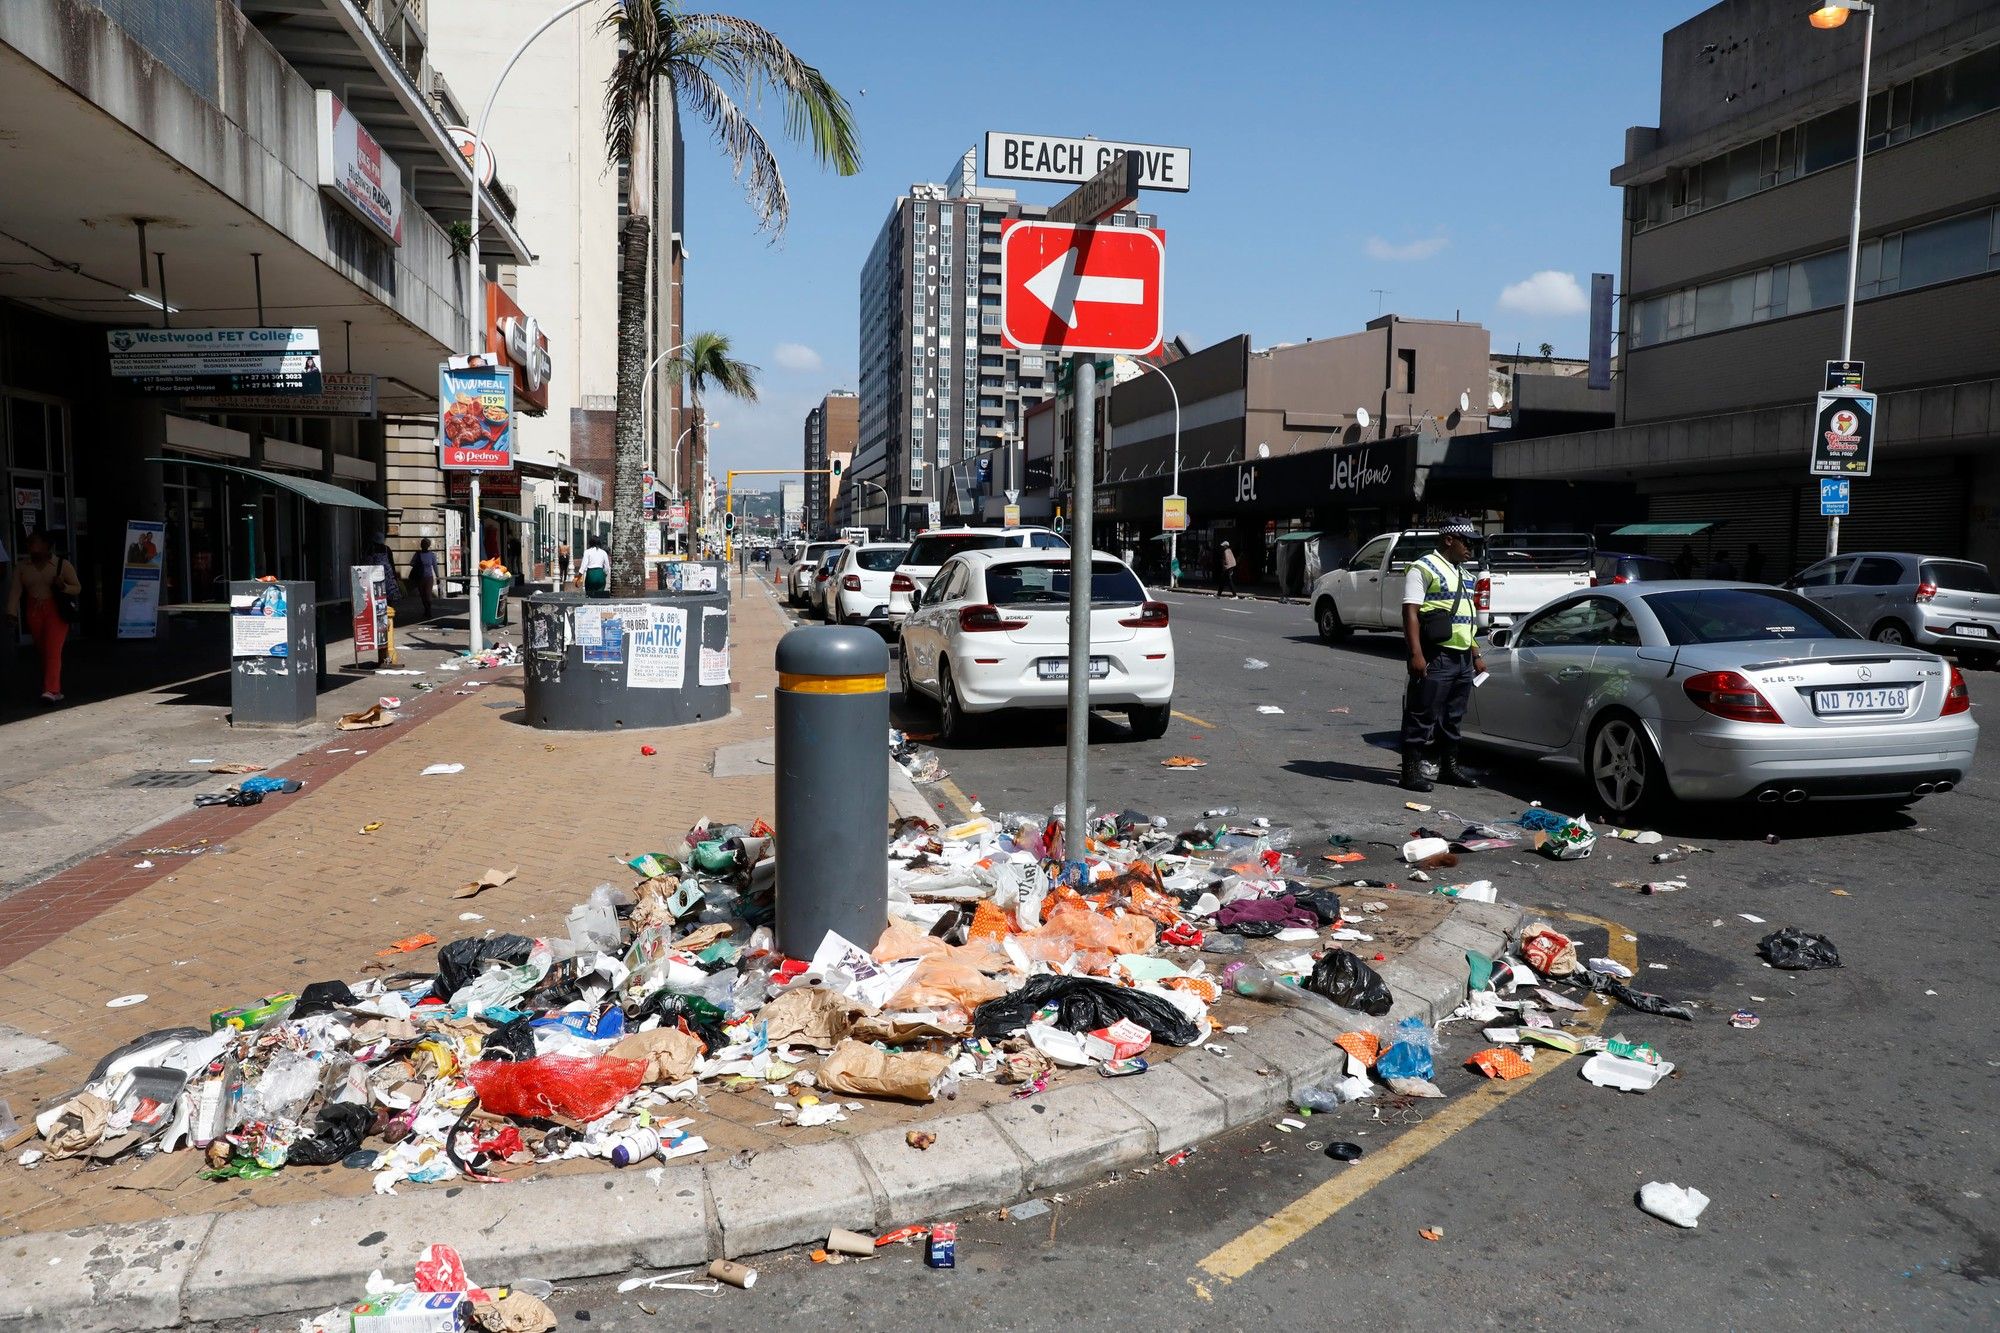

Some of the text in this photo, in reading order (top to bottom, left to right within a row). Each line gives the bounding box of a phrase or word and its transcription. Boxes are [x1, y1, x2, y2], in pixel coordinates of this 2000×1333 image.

[1004, 139, 1083, 175] BEACH
[348, 162, 371, 199] Highway
[372, 185, 392, 216] RADIO
[1074, 174, 1109, 223] LEMBEDE
[1111, 163, 1123, 198] ST
[926, 224, 937, 419] PROVINCIAL
[136, 330, 304, 344] Westwood FET College
[478, 379, 505, 389] MEAL
[466, 450, 500, 461] Pedros
[1353, 448, 1392, 495] Home
[659, 612, 665, 623] &
[635, 624, 682, 647] MATRIC
[636, 646, 678, 655] PASS RATE
[1047, 661, 1060, 672] NP
[1761, 675, 1785, 683] SLK
[1820, 692, 1840, 709] ND
